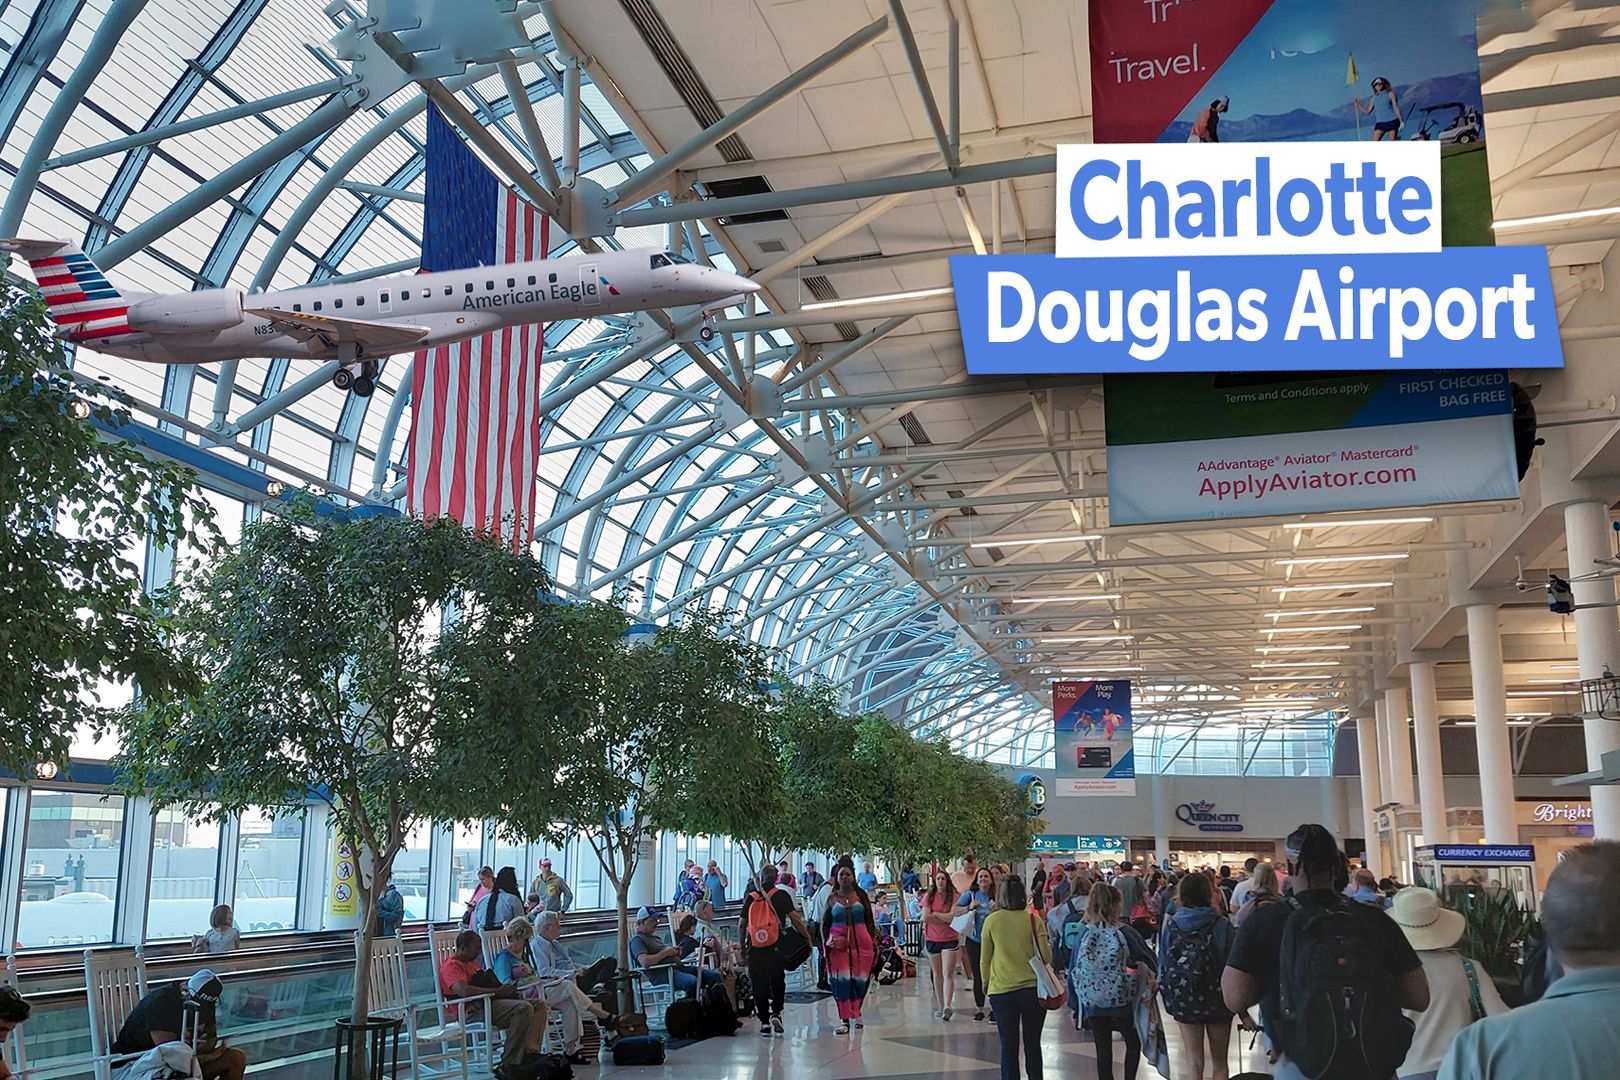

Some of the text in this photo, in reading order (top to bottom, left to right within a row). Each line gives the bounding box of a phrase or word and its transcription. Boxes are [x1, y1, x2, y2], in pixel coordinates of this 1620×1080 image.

[1108, 43, 1206, 84] Travel.
[463, 281, 597, 310] American Eagle
[1399, 373, 1504, 394] FIRST CHECKED
[1225, 393, 1257, 404] Terms
[1258, 390, 1279, 401] and
[1280, 385, 1338, 399] Conditions
[1440, 390, 1506, 407] BAG FREE
[1199, 467, 1417, 500] ApplyAviator.com
[1438, 848, 1483, 857] CURRENCY
[1484, 848, 1531, 857] EXCHANGE
